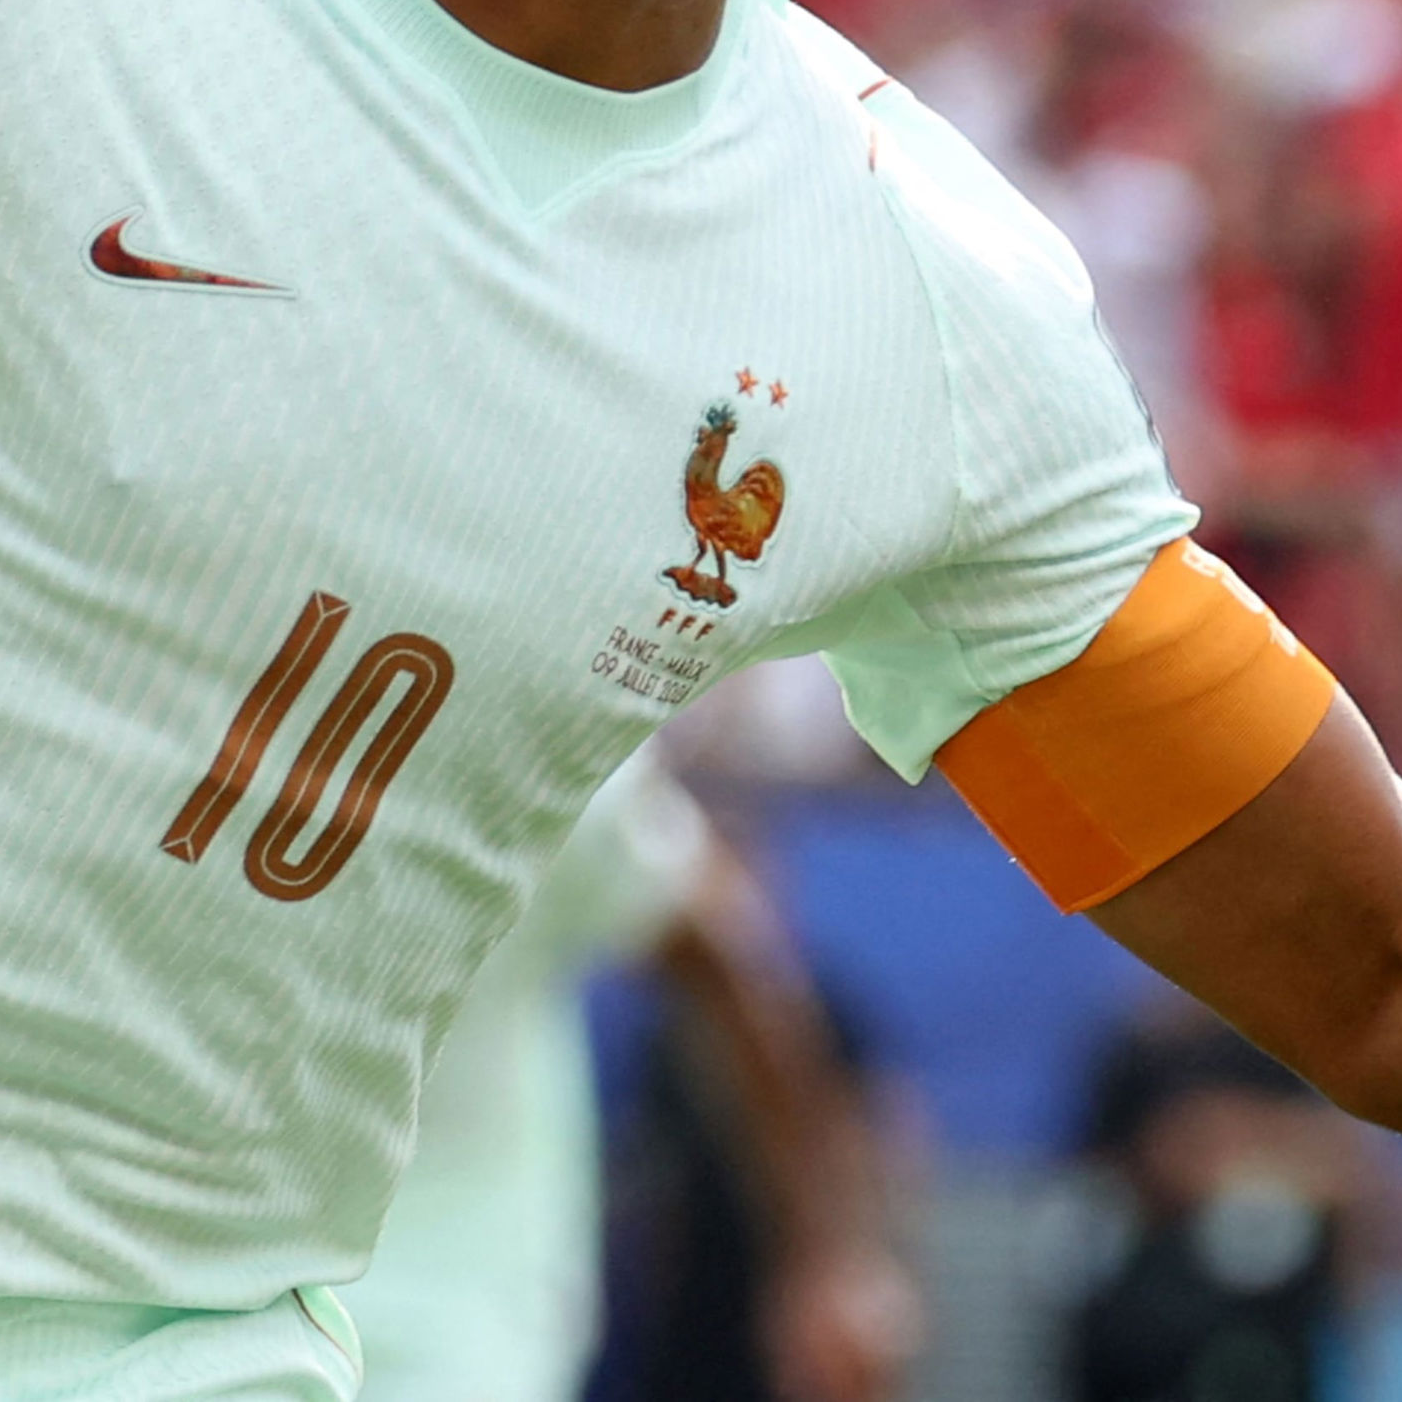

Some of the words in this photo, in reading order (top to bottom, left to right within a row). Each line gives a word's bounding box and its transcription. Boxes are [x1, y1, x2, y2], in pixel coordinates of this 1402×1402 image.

[606, 625, 660, 665] FRANCE
[591, 651, 619, 676] 09
[615, 664, 660, 696] JUILLET
[158, 590, 454, 902] 10
